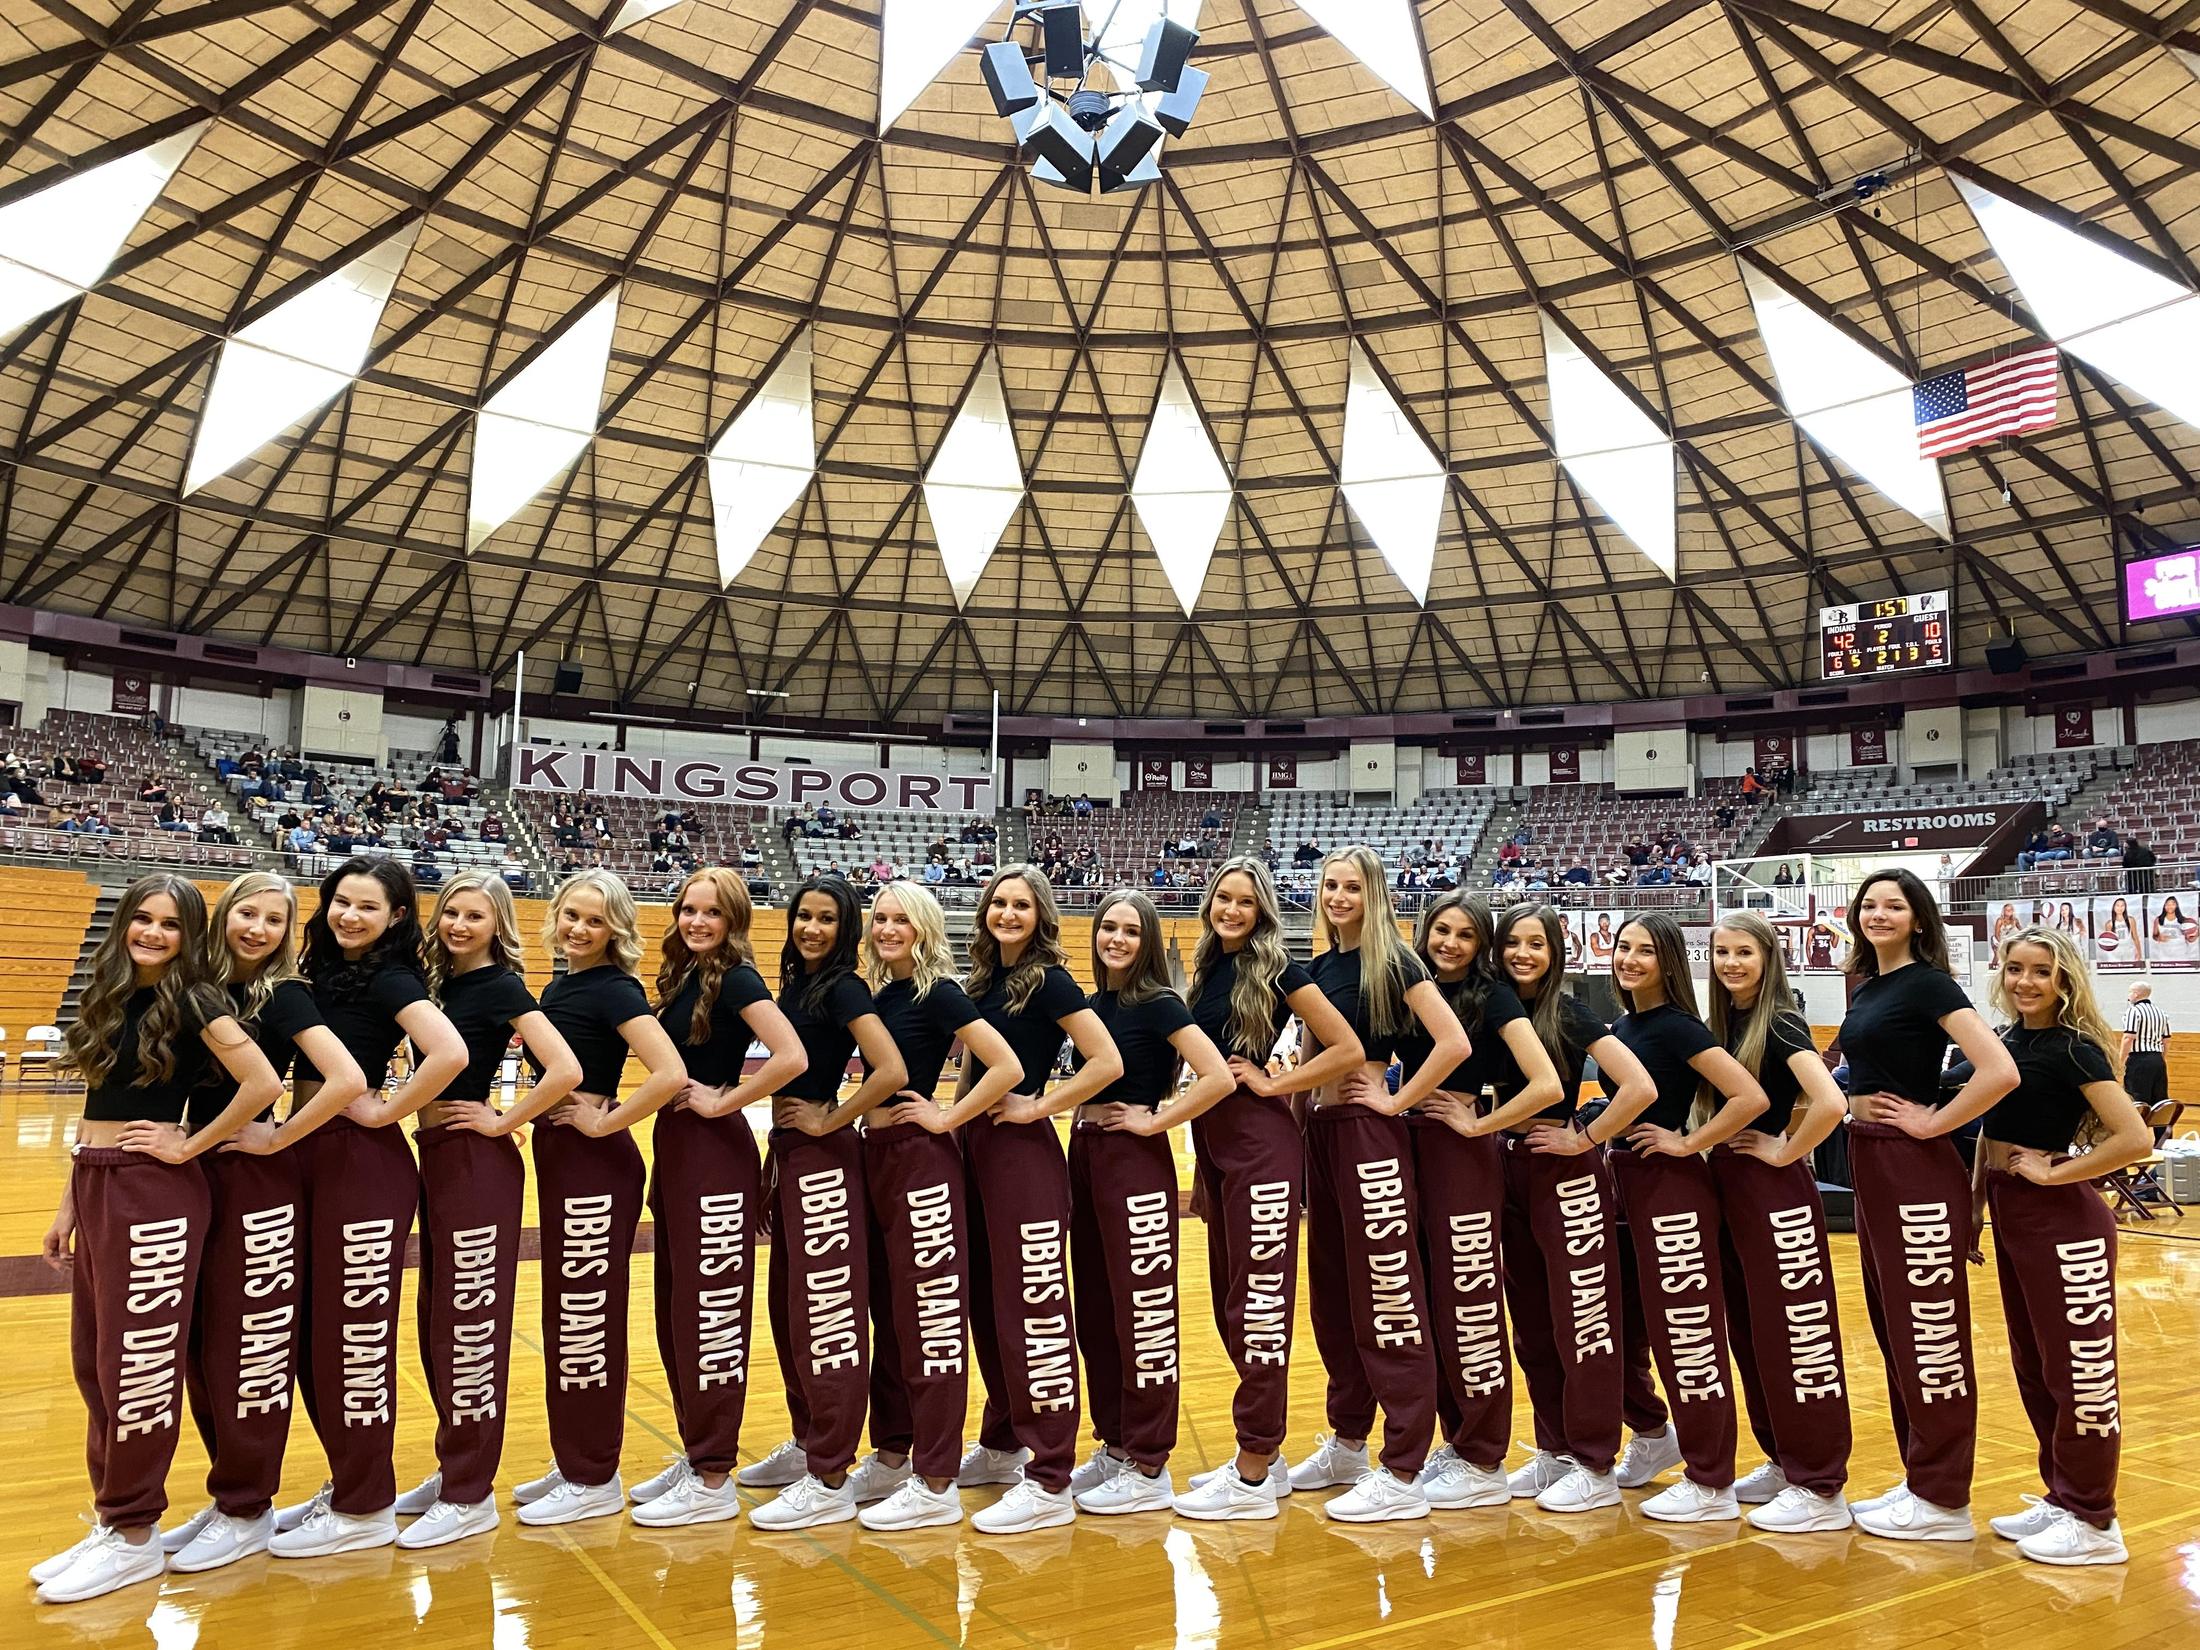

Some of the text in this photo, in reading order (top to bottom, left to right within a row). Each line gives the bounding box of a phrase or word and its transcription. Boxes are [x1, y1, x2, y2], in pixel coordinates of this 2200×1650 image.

[1827, 623, 1856, 635] INDIANS
[1834, 633, 1855, 649] 42
[1834, 657, 1843, 669] 6
[1851, 655, 1861, 667] 5
[1875, 598, 1907, 618] 1:57
[1878, 630, 1889, 644] 2
[1909, 647, 1919, 660] 3
[1913, 612, 1939, 623] GUEST
[1924, 621, 1941, 638] 10
[1931, 645, 1941, 657] 5
[515, 747, 993, 811] KINGSPORT
[1863, 812, 1996, 833] RESTROOMS
[117, 1217, 187, 1441] DBHS DANCE
[237, 1204, 294, 1418] DBHS DANCE
[343, 1219, 393, 1427] DBHS DANCE
[452, 1225, 497, 1425] DBHS DANCE
[560, 1195, 612, 1391] DBHS DANCE
[699, 1193, 743, 1390] DBHS DANCE
[799, 1168, 859, 1375] DBHS DANCE
[907, 1183, 962, 1376] DBHS DANCE
[1021, 1220, 1075, 1413] DBHS DANCE
[1127, 1192, 1177, 1388] DBHS DANCE
[1244, 1181, 1289, 1366] DBHS DANCE
[1357, 1158, 1422, 1348] DBHS DANCE
[1450, 1212, 1506, 1398] DBHS DANCE
[1557, 1174, 1613, 1363] DBHS DANCE
[1652, 1212, 1726, 1404] DBHS DANCE
[1770, 1206, 1841, 1402] DBHS DANCE
[1899, 1203, 1967, 1403] DBHS DANCE
[2056, 1238, 2120, 1437] DBHS DANCE
